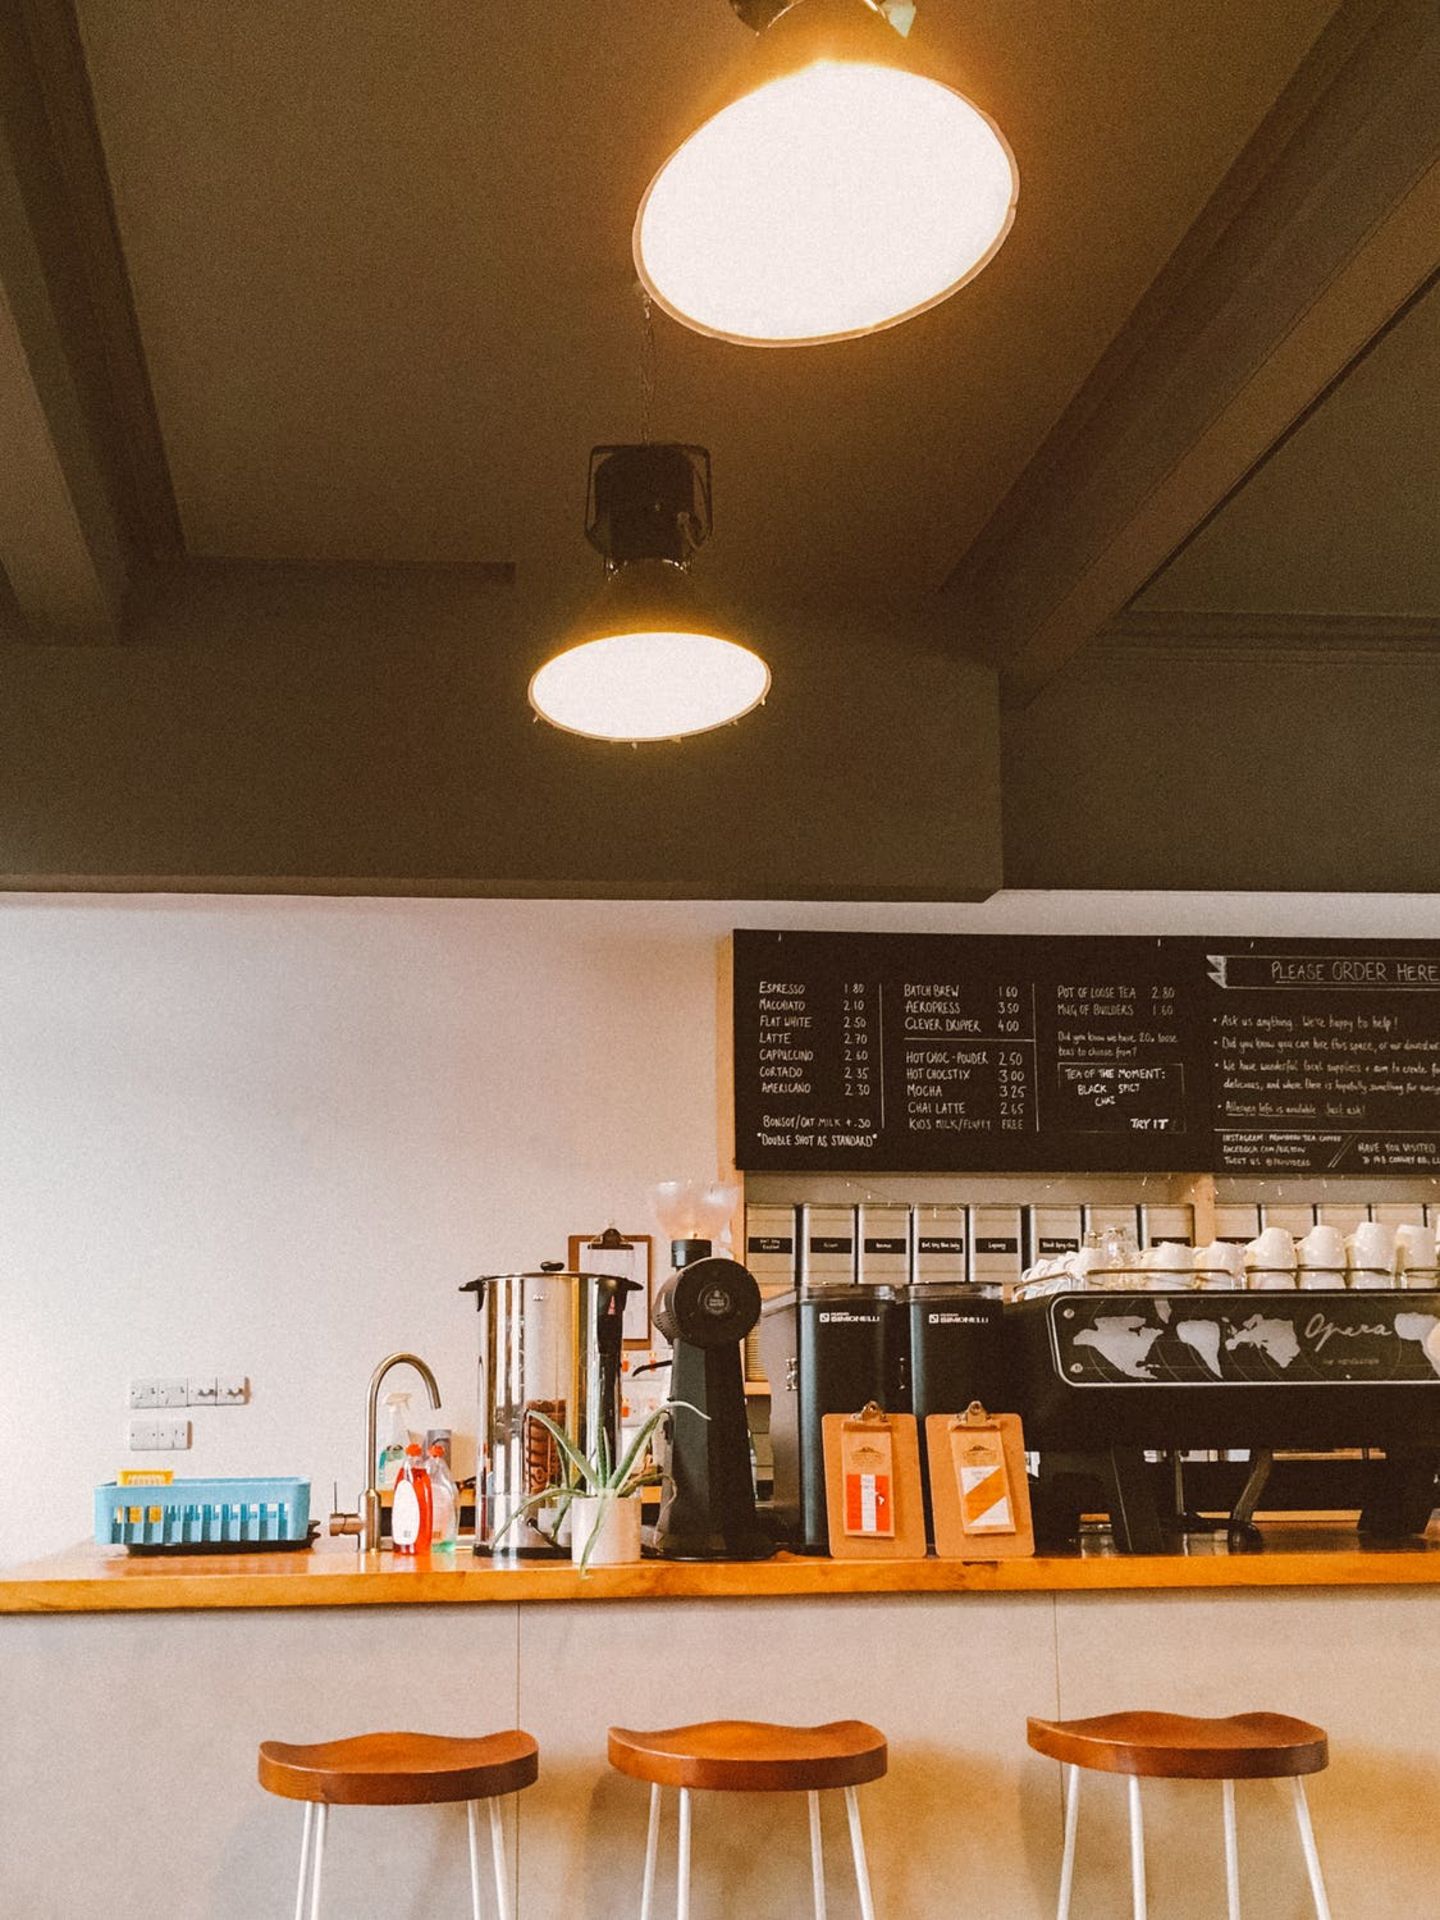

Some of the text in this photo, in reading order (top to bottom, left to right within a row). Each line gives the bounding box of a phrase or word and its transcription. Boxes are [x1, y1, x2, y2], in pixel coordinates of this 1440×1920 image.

[1271, 960, 1440, 982] PLEASE ORDER HERE
[759, 981, 806, 995] ESPRESSO
[904, 984, 931, 997] BATCH
[933, 984, 960, 998] BREW
[1118, 986, 1137, 999] TEA
[905, 1000, 960, 1014] AEROPRESS
[760, 1032, 792, 1044] LATTE
[906, 1051, 925, 1064] HOT
[760, 1066, 803, 1078] CORTADO
[762, 1082, 811, 1094] AMERICANO
[907, 1083, 943, 1097] MOCHA
[1077, 1084, 1107, 1095] BLACK
[935, 1102, 966, 1114] LATTE
[1130, 1118, 1169, 1130] TRY IT
[795, 1134, 814, 1147] SHOT
[817, 1135, 828, 1147] AS
[1304, 1313, 1392, 1353] Opera
